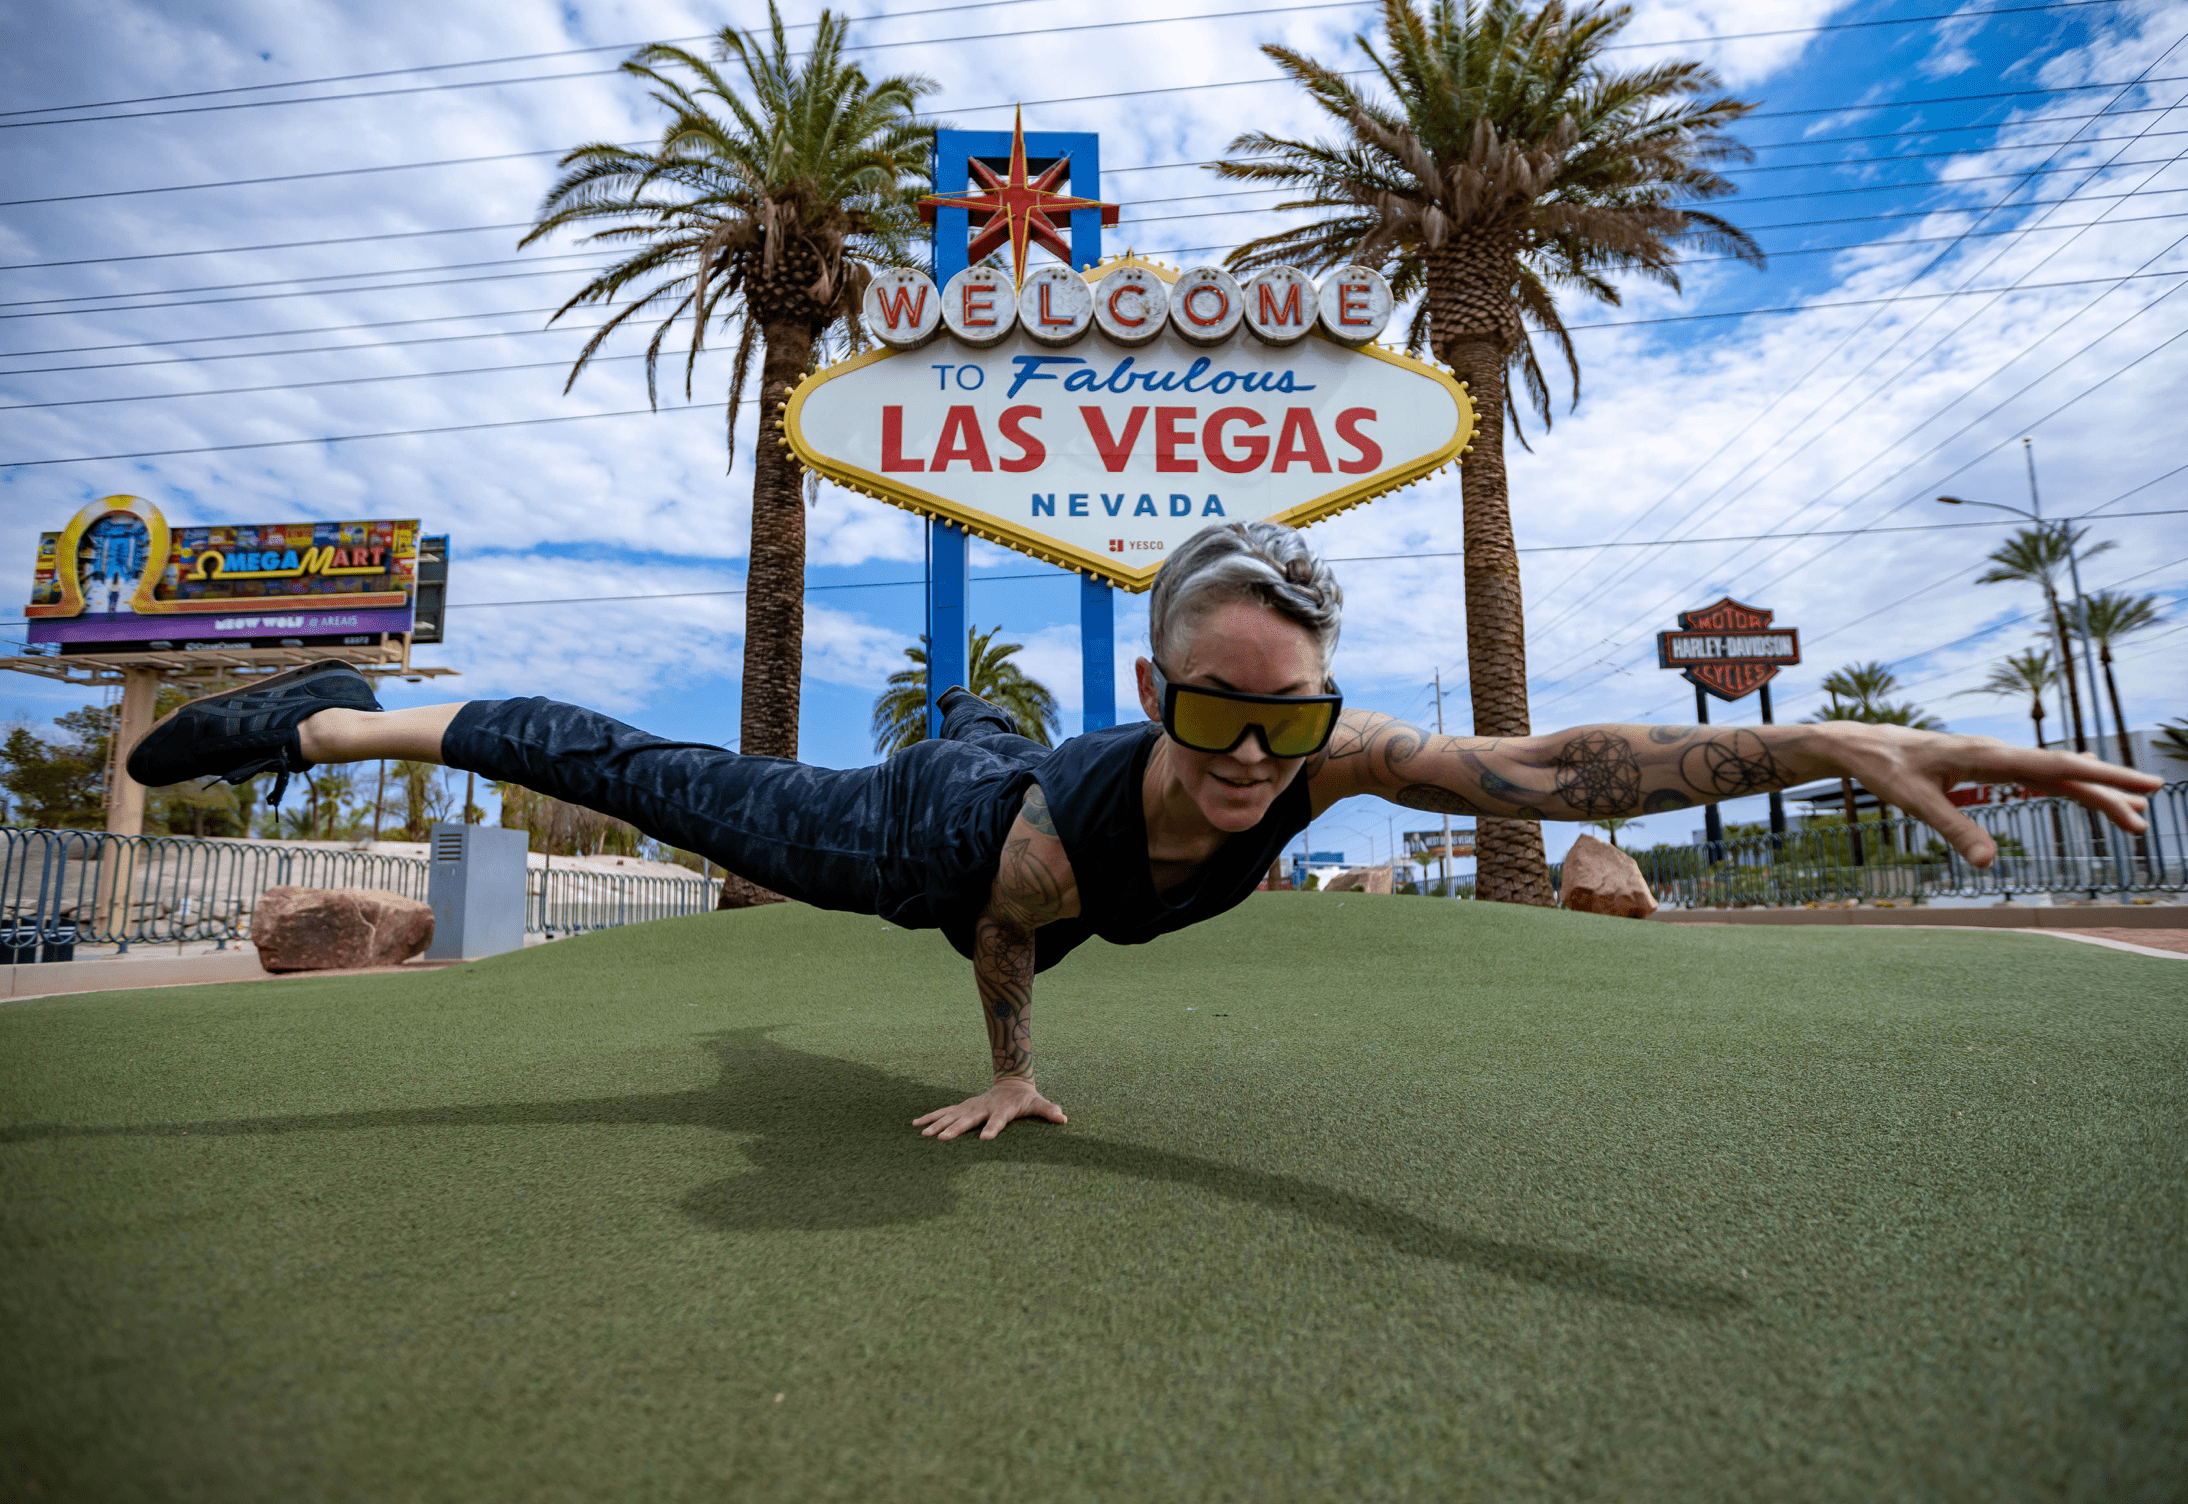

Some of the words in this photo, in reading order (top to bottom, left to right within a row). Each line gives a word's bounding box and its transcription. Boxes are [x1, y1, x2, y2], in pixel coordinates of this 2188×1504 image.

[876, 283, 1373, 330] WELCOME
[931, 364, 985, 391] TO
[1006, 354, 1318, 400] Fabulous
[881, 404, 1047, 473] LAS
[1078, 405, 1385, 475] VEGAS
[1031, 493, 1226, 517] NEVADA
[1129, 540, 1164, 550] YESCO
[1698, 607, 1762, 629] MOTOR
[1672, 635, 1793, 659] HARLEY-DAVIDSON
[1703, 664, 1766, 690] CYCLES
